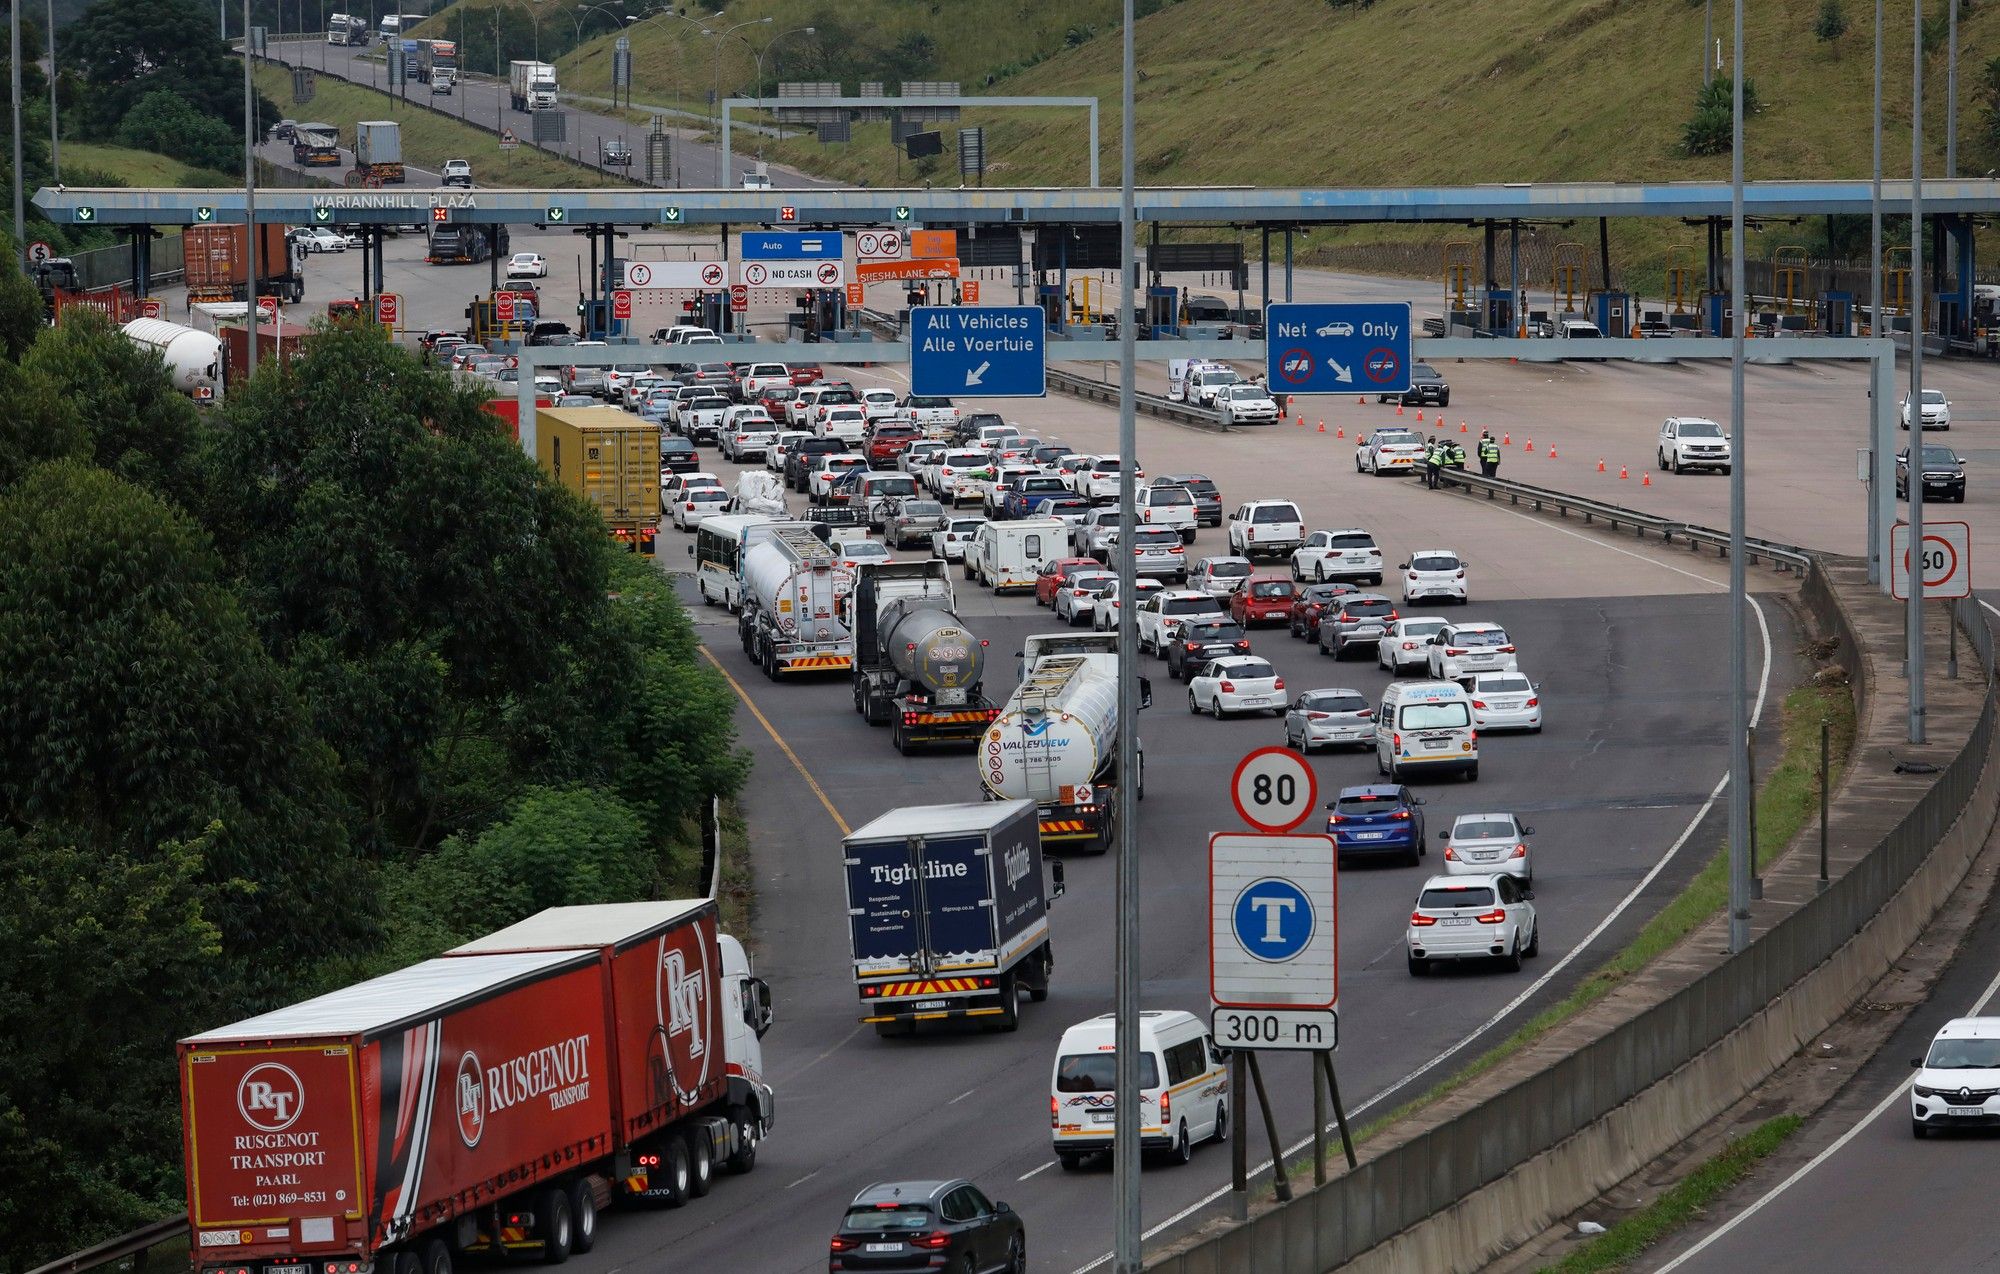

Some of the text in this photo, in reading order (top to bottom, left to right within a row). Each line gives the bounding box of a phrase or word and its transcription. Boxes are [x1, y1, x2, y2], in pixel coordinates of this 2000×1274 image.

[313, 195, 477, 208] MARIANNHILL PLAZA
[762, 241, 783, 250] Auto
[772, 270, 812, 279] NO CASH
[859, 269, 926, 283] SHESHA LANE
[927, 314, 1029, 329] All Vehicles
[1278, 321, 1399, 340] Net Only
[923, 336, 1034, 352] Alle Voertuie
[1921, 550, 1944, 570] 60
[1253, 773, 1296, 806] 80
[868, 894, 901, 902] Responsible
[1251, 896, 1297, 943] T
[664, 948, 704, 1059] RT
[1226, 1015, 1322, 1043] 300 m
[487, 1034, 589, 1113] RUSGENOT
[247, 1081, 294, 1121] RT
[460, 1073, 481, 1125] RT
[549, 1081, 590, 1111] TRANSPORT
[235, 1131, 320, 1150] RUSGENOT
[230, 1151, 326, 1170] TRANSPORT
[255, 1173, 301, 1187] PAARL
[231, 1191, 327, 1208] Tel: (021) 869-8531
[634, 1188, 670, 1196] OLVO
